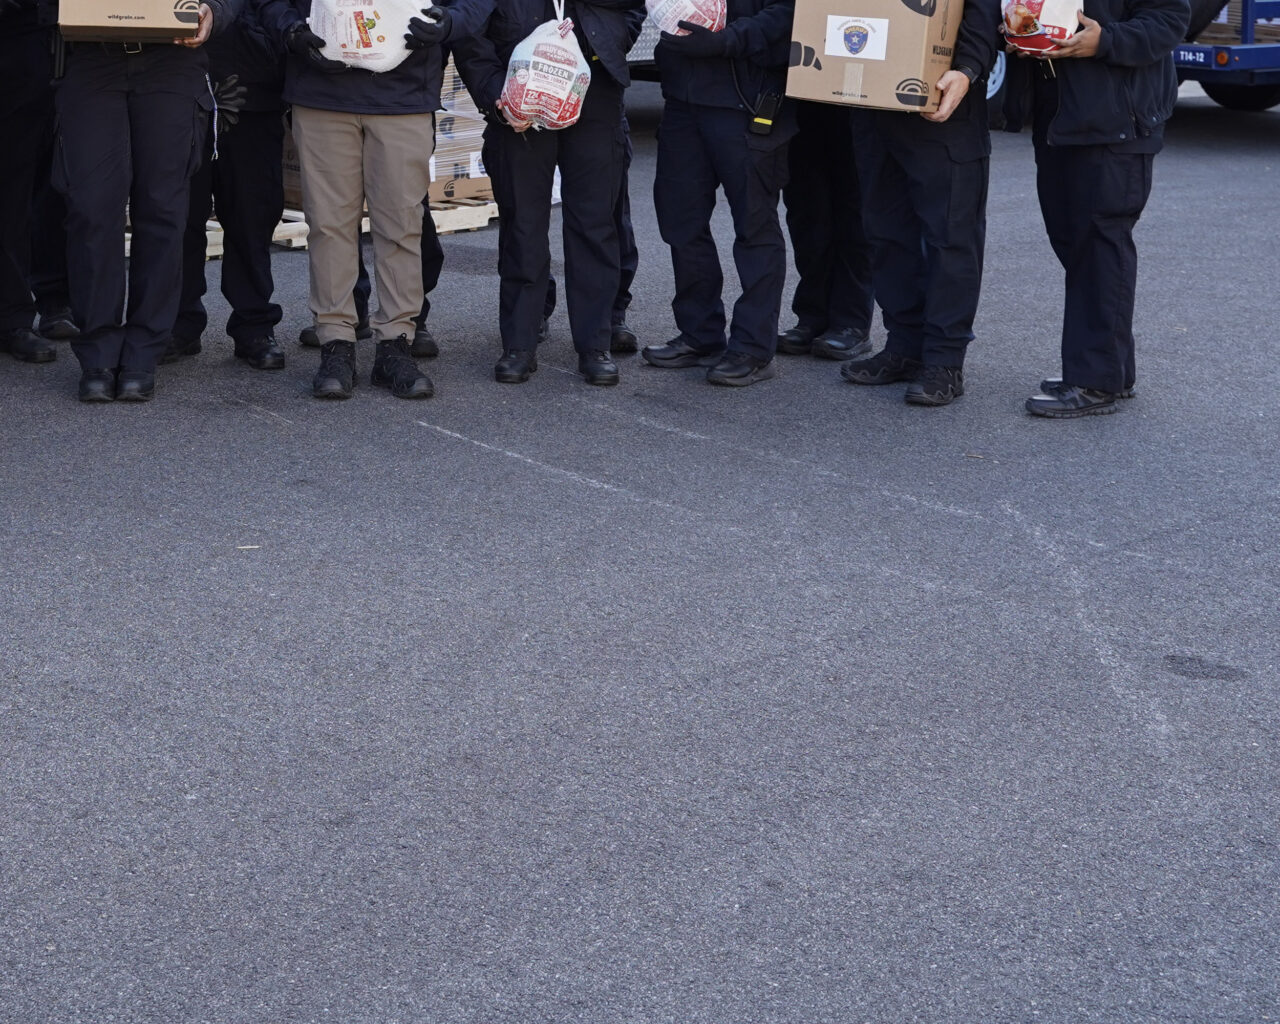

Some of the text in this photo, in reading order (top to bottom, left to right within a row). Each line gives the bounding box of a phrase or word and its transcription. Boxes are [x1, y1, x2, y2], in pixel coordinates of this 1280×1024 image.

[845, 26, 868, 34] SHERIFF
[1179, 51, 1205, 62] T14-12
[538, 63, 569, 79] FROZEN
[534, 72, 568, 86] YOUNG TURKEY
